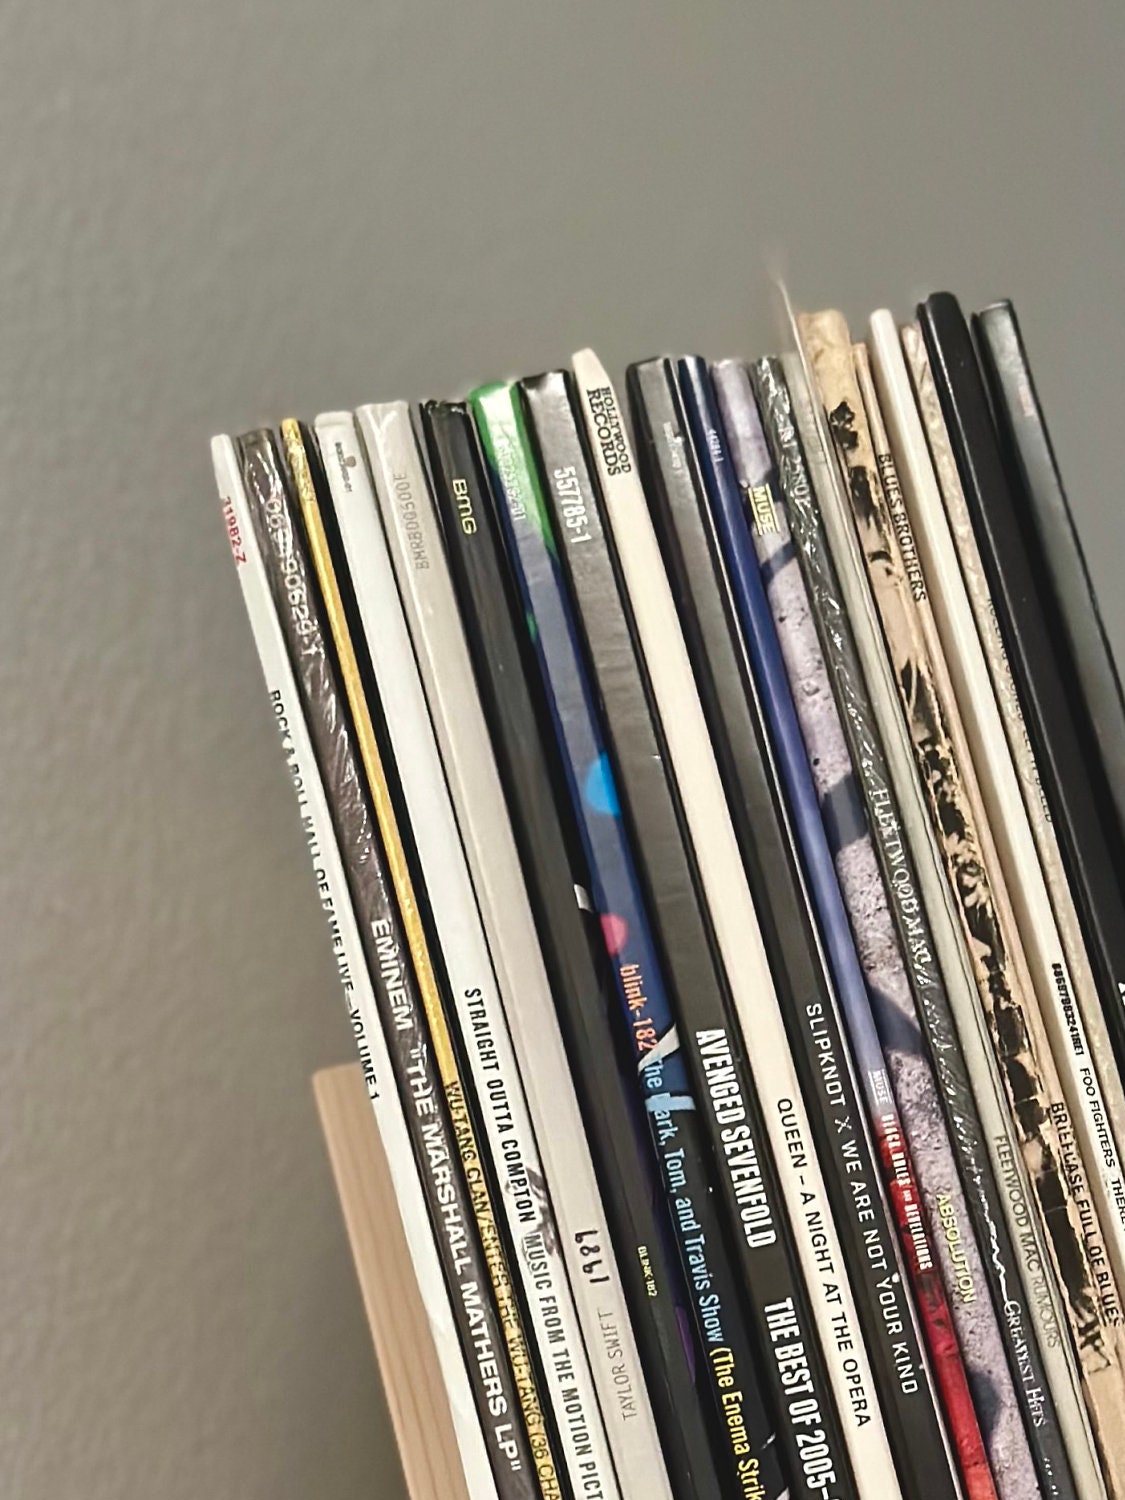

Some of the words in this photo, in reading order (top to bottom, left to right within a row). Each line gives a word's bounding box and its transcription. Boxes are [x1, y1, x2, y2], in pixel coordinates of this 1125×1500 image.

[586, 387, 621, 477] RECORDS
[599, 386, 632, 474] HOLLYWOOD
[451, 478, 477, 534] BMG
[552, 466, 591, 544] 557785-1
[750, 485, 777, 535] MUSE
[875, 453, 903, 508] BLUES
[890, 511, 928, 603] BROTHERS
[268, 689, 291, 741] ROCK
[869, 788, 919, 916] FLEETWOOD
[903, 916, 931, 966] MAC
[464, 987, 499, 1073] STRAIGHT
[617, 962, 659, 1051] blink-182
[694, 1026, 747, 1125] AVENGED
[804, 1002, 846, 1108] SLIPKNOT
[486, 1077, 514, 1134] OUTTA
[869, 1068, 890, 1105] MUSE
[775, 1097, 808, 1170] QUEEN
[832, 1115, 853, 1134] X
[879, 1112, 902, 1148] BLACK
[1078, 1067, 1097, 1097] FOO
[1088, 1099, 1115, 1168] FIGHTERS
[660, 1147, 692, 1194] Tom,
[838, 1139, 863, 1173] WE
[889, 1150, 912, 1187] HOLES
[1049, 1101, 1087, 1194] BRIEFCASE
[370, 918, 413, 1031] EMINEM
[402, 1048, 434, 1117] "THE
[420, 1122, 473, 1275] MARSHALL
[459, 1280, 508, 1418] MATHERS
[494, 1423, 522, 1473] LP"
[500, 1138, 536, 1223] COMPTON
[718, 1124, 778, 1249] SEVENFOLD
[798, 1189, 817, 1205] A
[849, 1178, 875, 1223] ARE
[675, 1195, 701, 1232] and
[903, 1202, 933, 1270] REVELATIONS
[991, 1134, 1029, 1228] FLEETWOOD
[1017, 1231, 1042, 1273] MAC
[1030, 1275, 1061, 1348] RUMOURS
[1074, 1198, 1099, 1239] FULL
[444, 1080, 476, 1163] WU-TANG
[506, 1334, 541, 1427] WU-TANG
[527, 1430, 551, 1461] (36
[522, 1233, 551, 1291] MUSIC
[573, 1228, 609, 1285] 1989
[682, 1233, 716, 1291] Travis
[804, 1210, 834, 1275] NIGHT
[862, 1228, 888, 1272] NOT
[934, 1191, 976, 1304] ABSOLUTION
[1086, 1244, 1107, 1270] OF
[537, 1294, 564, 1344] FROM
[696, 1292, 729, 1344] Show
[762, 1296, 800, 1341] THE
[821, 1280, 843, 1308] AT
[874, 1276, 904, 1336] YOUR
[1094, 1271, 1122, 1329] BLUES
[597, 1309, 623, 1360] SWIFT
[829, 1311, 853, 1353] THE
[550, 1348, 574, 1383] THE
[610, 1363, 638, 1421] TAYLOR
[707, 1345, 739, 1389] (The
[773, 1342, 814, 1399] BEST
[840, 1357, 872, 1428] OPERA
[890, 1341, 919, 1395] KIND
[560, 1387, 591, 1457] MOTION
[719, 1390, 755, 1456] Enema
[786, 1398, 821, 1429] OF
